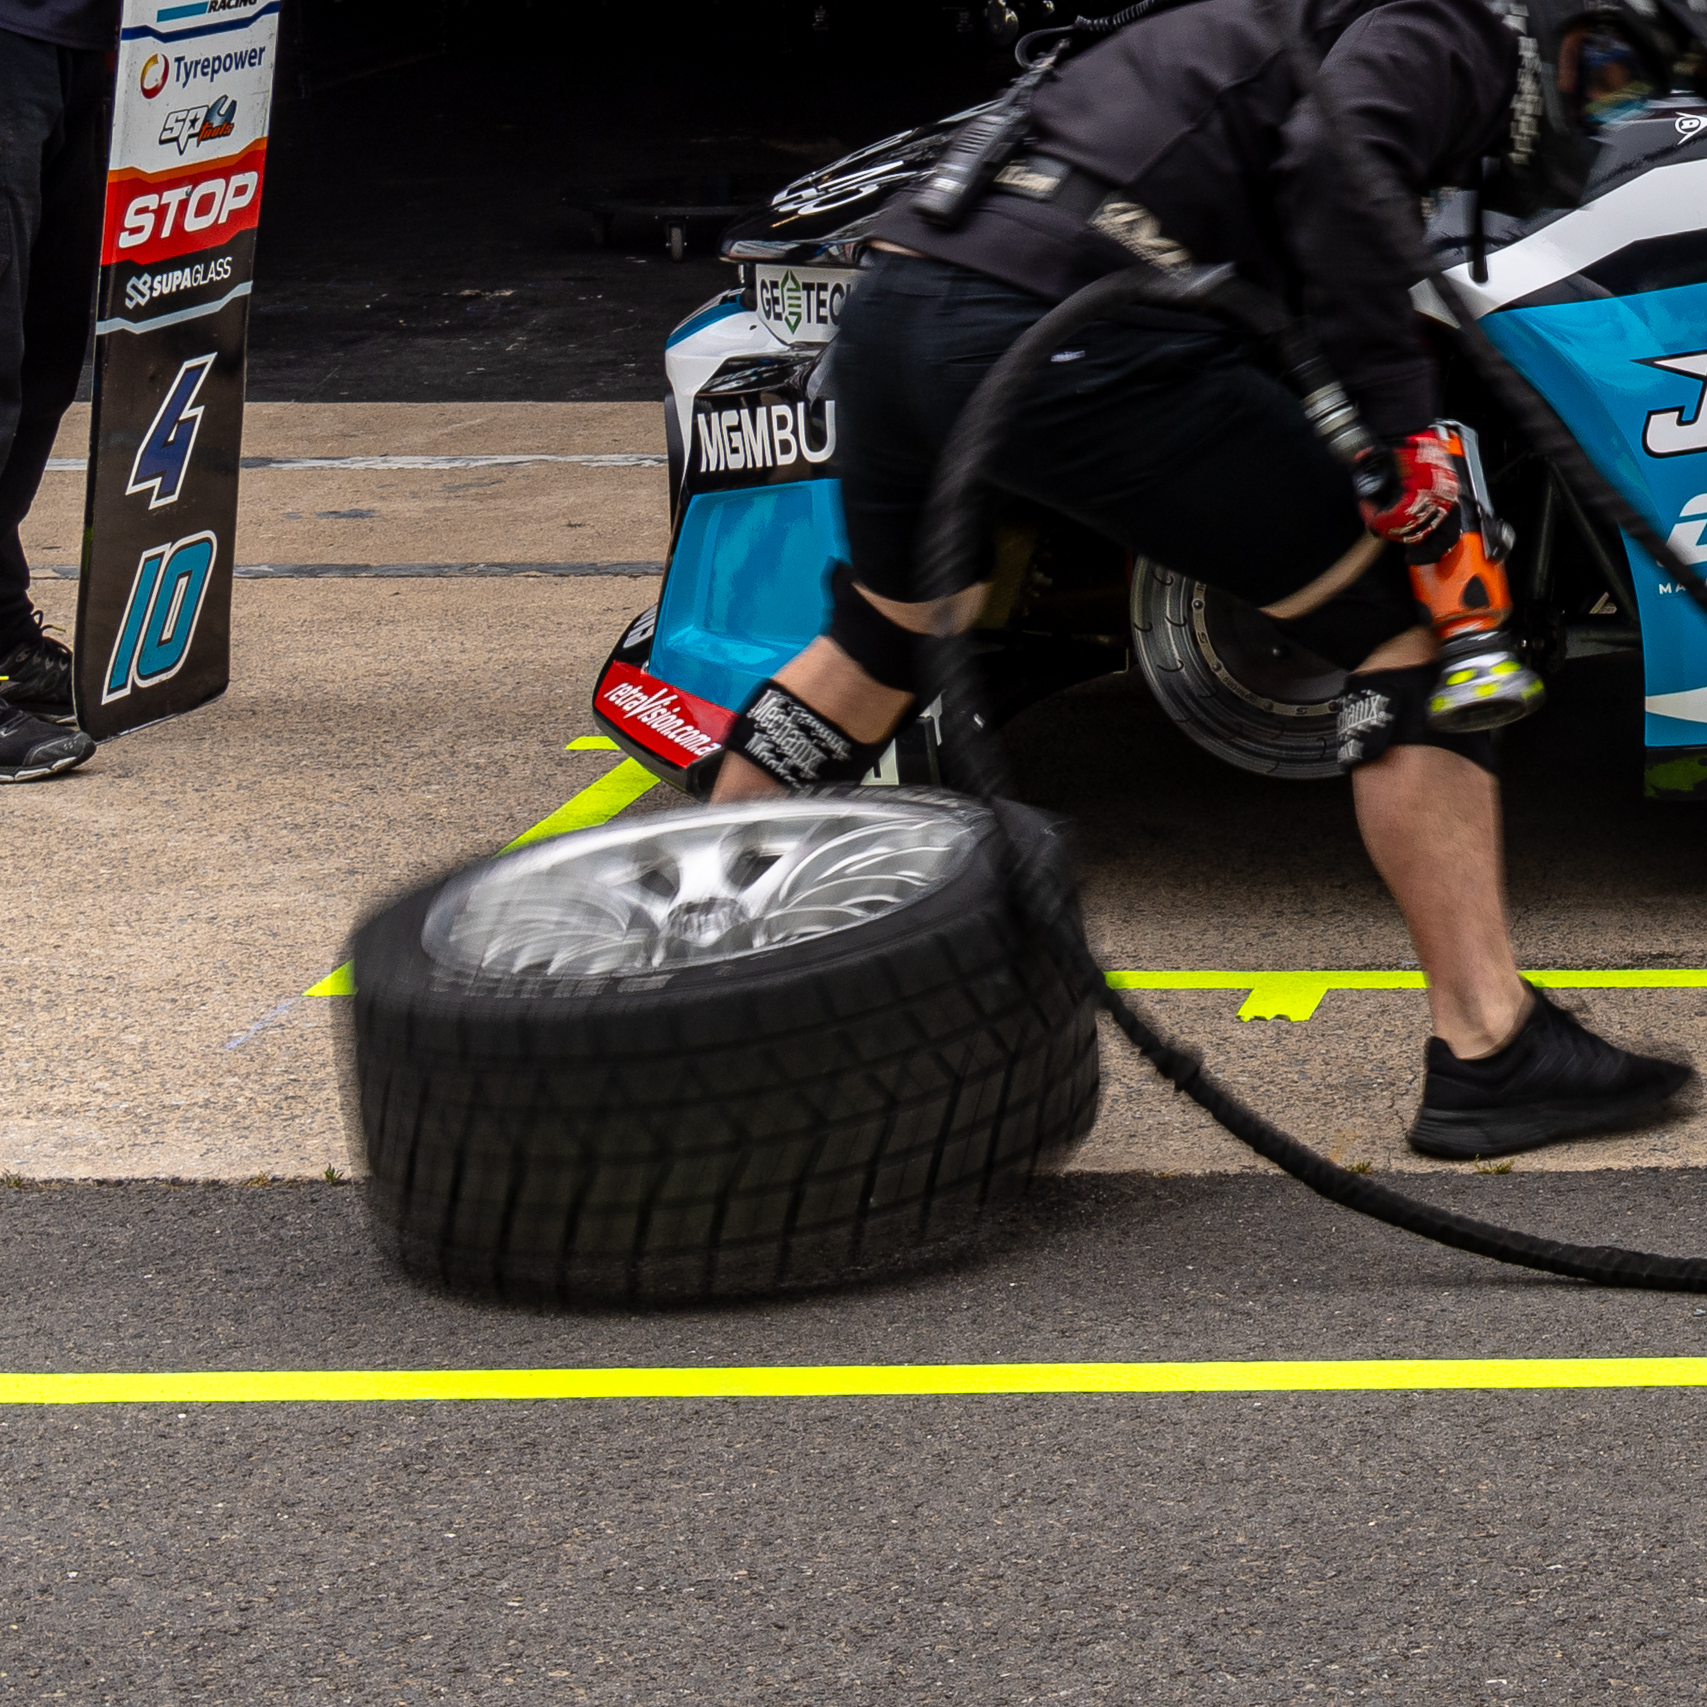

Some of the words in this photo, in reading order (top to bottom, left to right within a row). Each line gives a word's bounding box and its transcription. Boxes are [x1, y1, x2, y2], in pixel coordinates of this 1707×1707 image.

[173, 44, 267, 90] Tyrepower
[118, 170, 259, 251] STOP
[151, 256, 233, 299] SUPAGLASS
[124, 350, 218, 511] 4
[100, 529, 218, 706] 10
